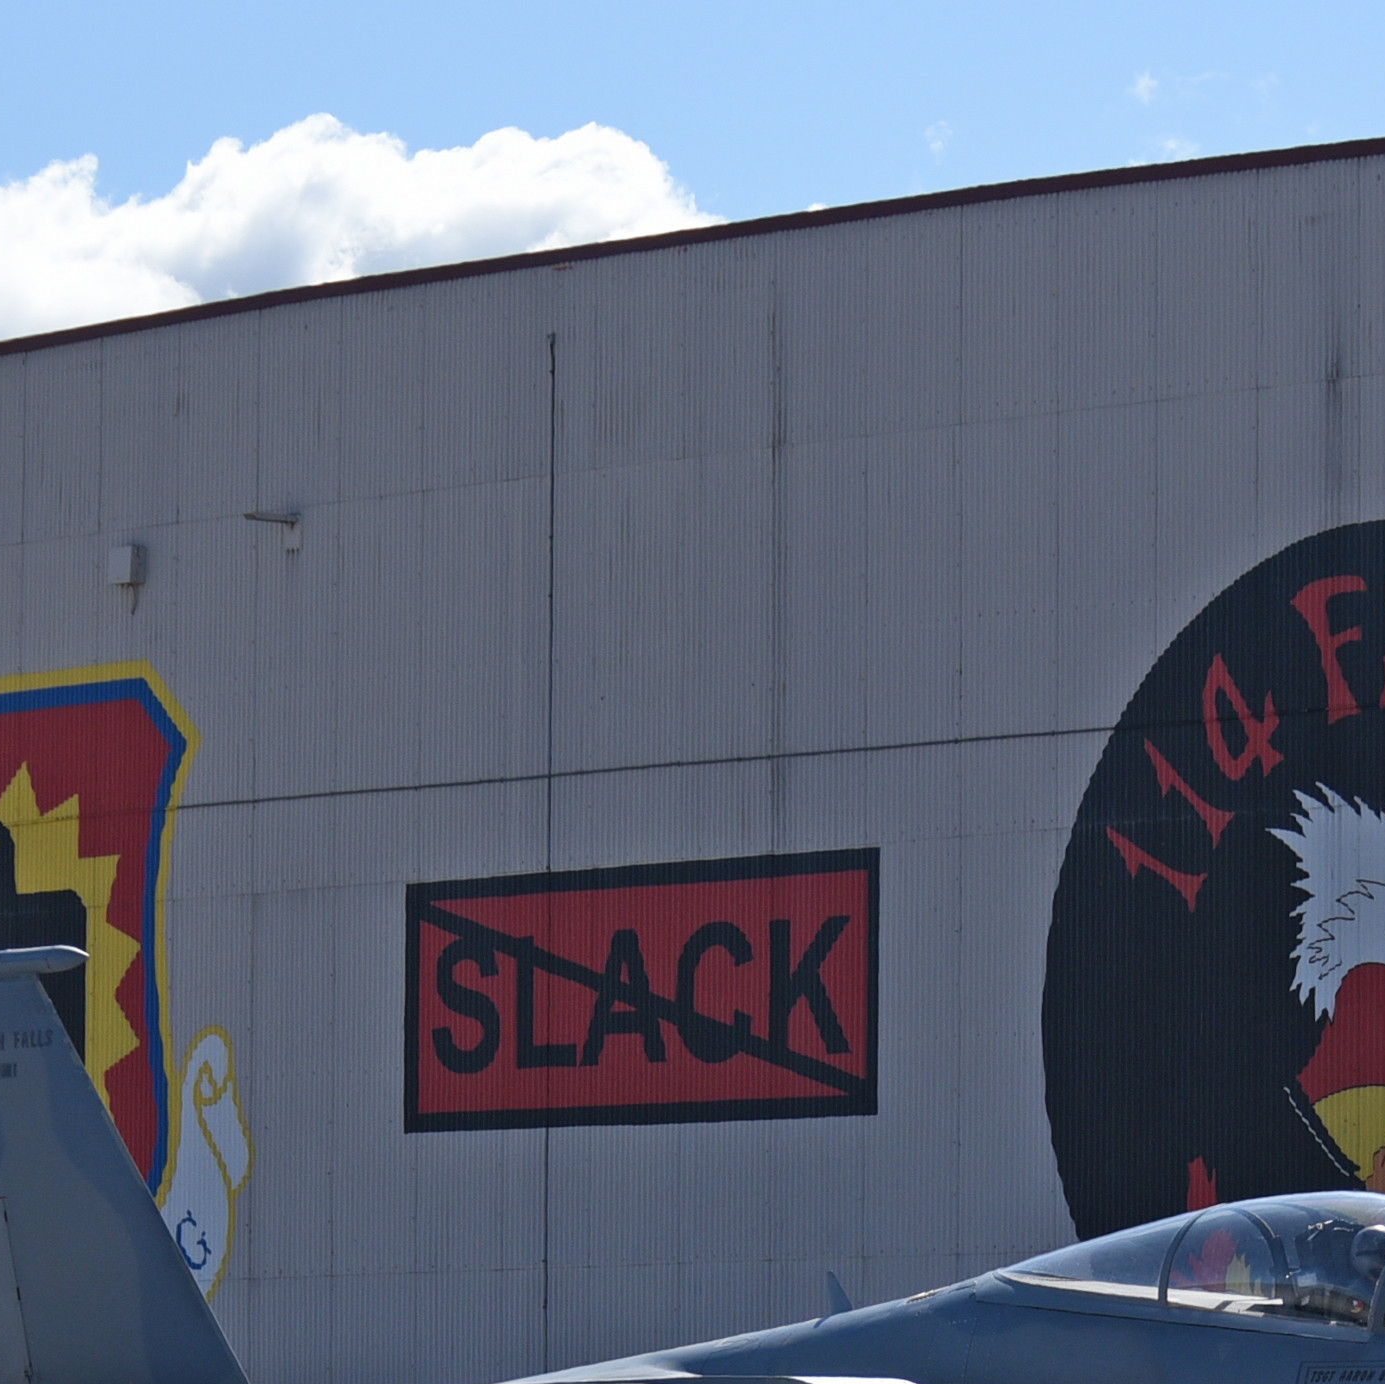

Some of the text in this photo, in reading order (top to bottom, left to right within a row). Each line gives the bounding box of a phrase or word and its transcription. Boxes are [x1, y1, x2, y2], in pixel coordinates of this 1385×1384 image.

[1106, 652, 1284, 913] 114
[13, 1029, 53, 1049] FALLS
[431, 914, 852, 1075] SLACK
[1310, 1370, 1336, 1383] TSGT
[1338, 1369, 1376, 1383] AARON
